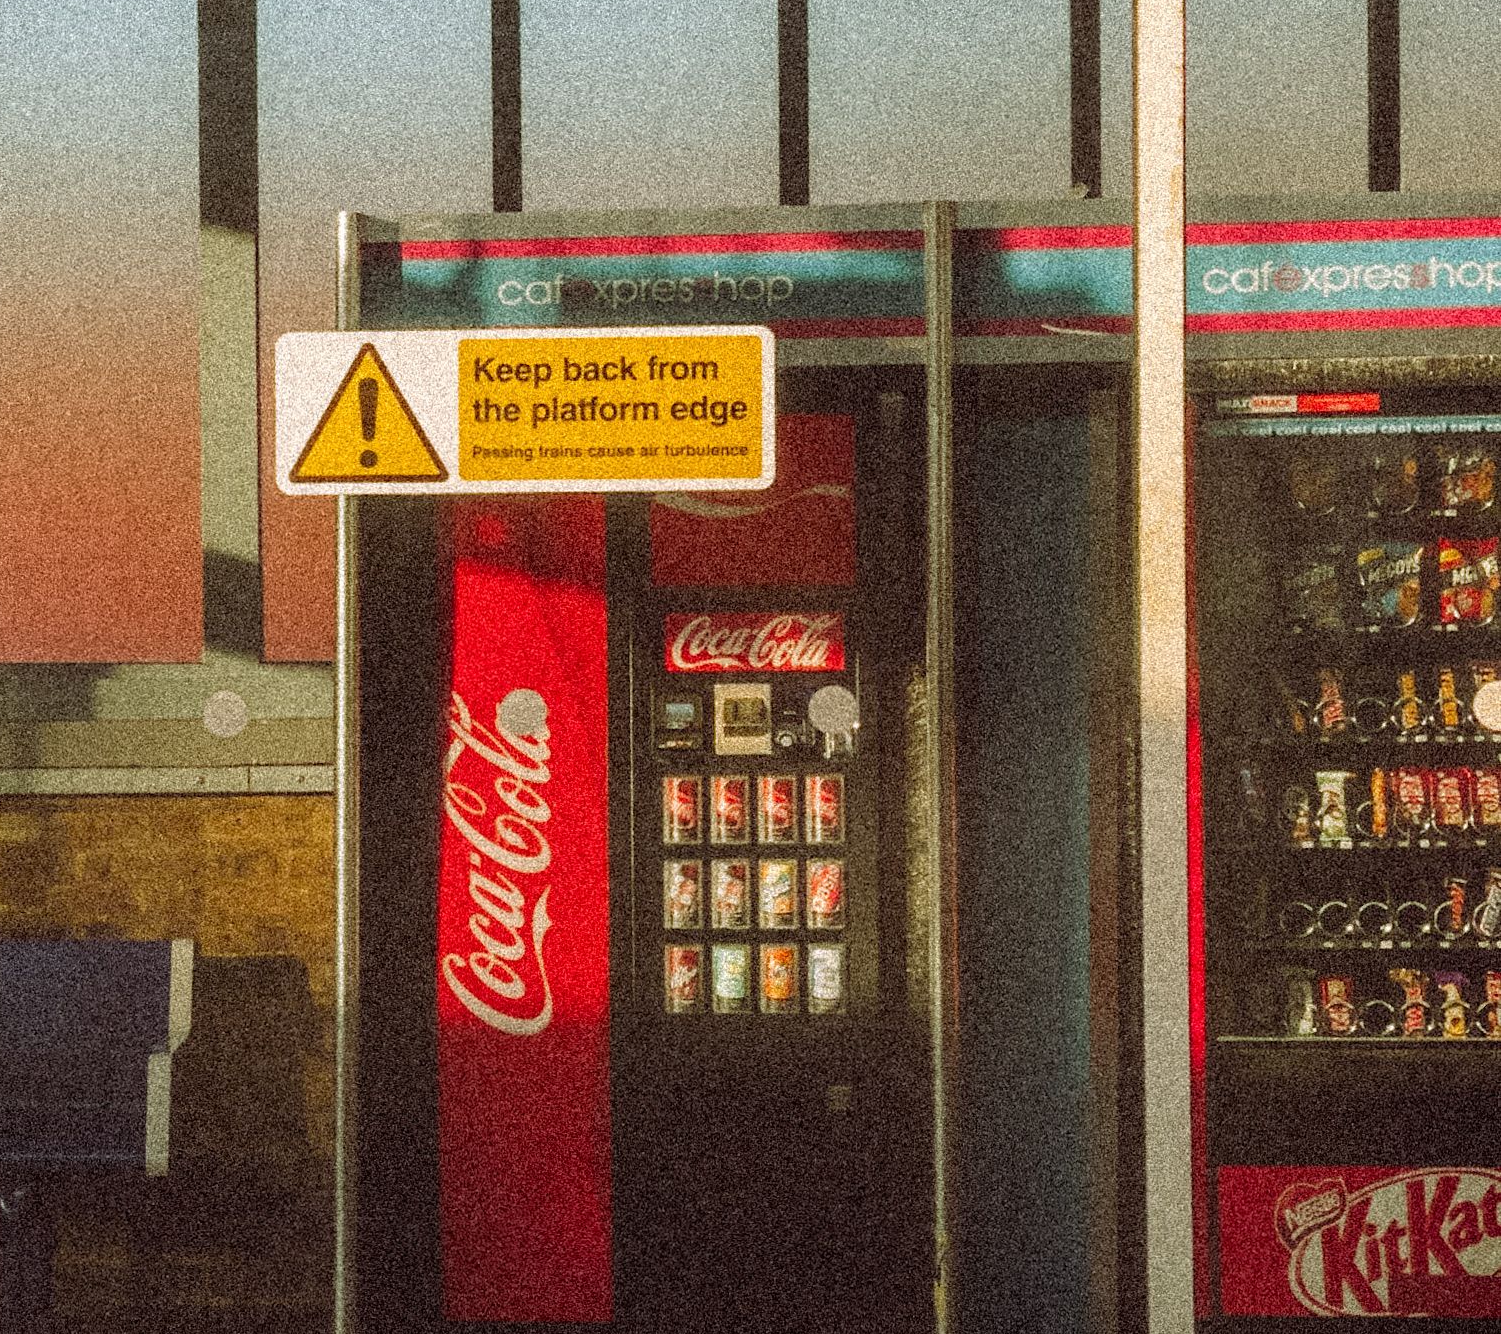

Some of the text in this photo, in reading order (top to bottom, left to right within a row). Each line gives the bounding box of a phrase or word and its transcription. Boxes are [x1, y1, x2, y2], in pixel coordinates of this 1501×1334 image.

[473, 355, 719, 389] Keep back from
[472, 395, 748, 429] the platform edge
[472, 443, 749, 462] Passing trains cause air turbulence
[672, 615, 839, 669] Coca-Cola
